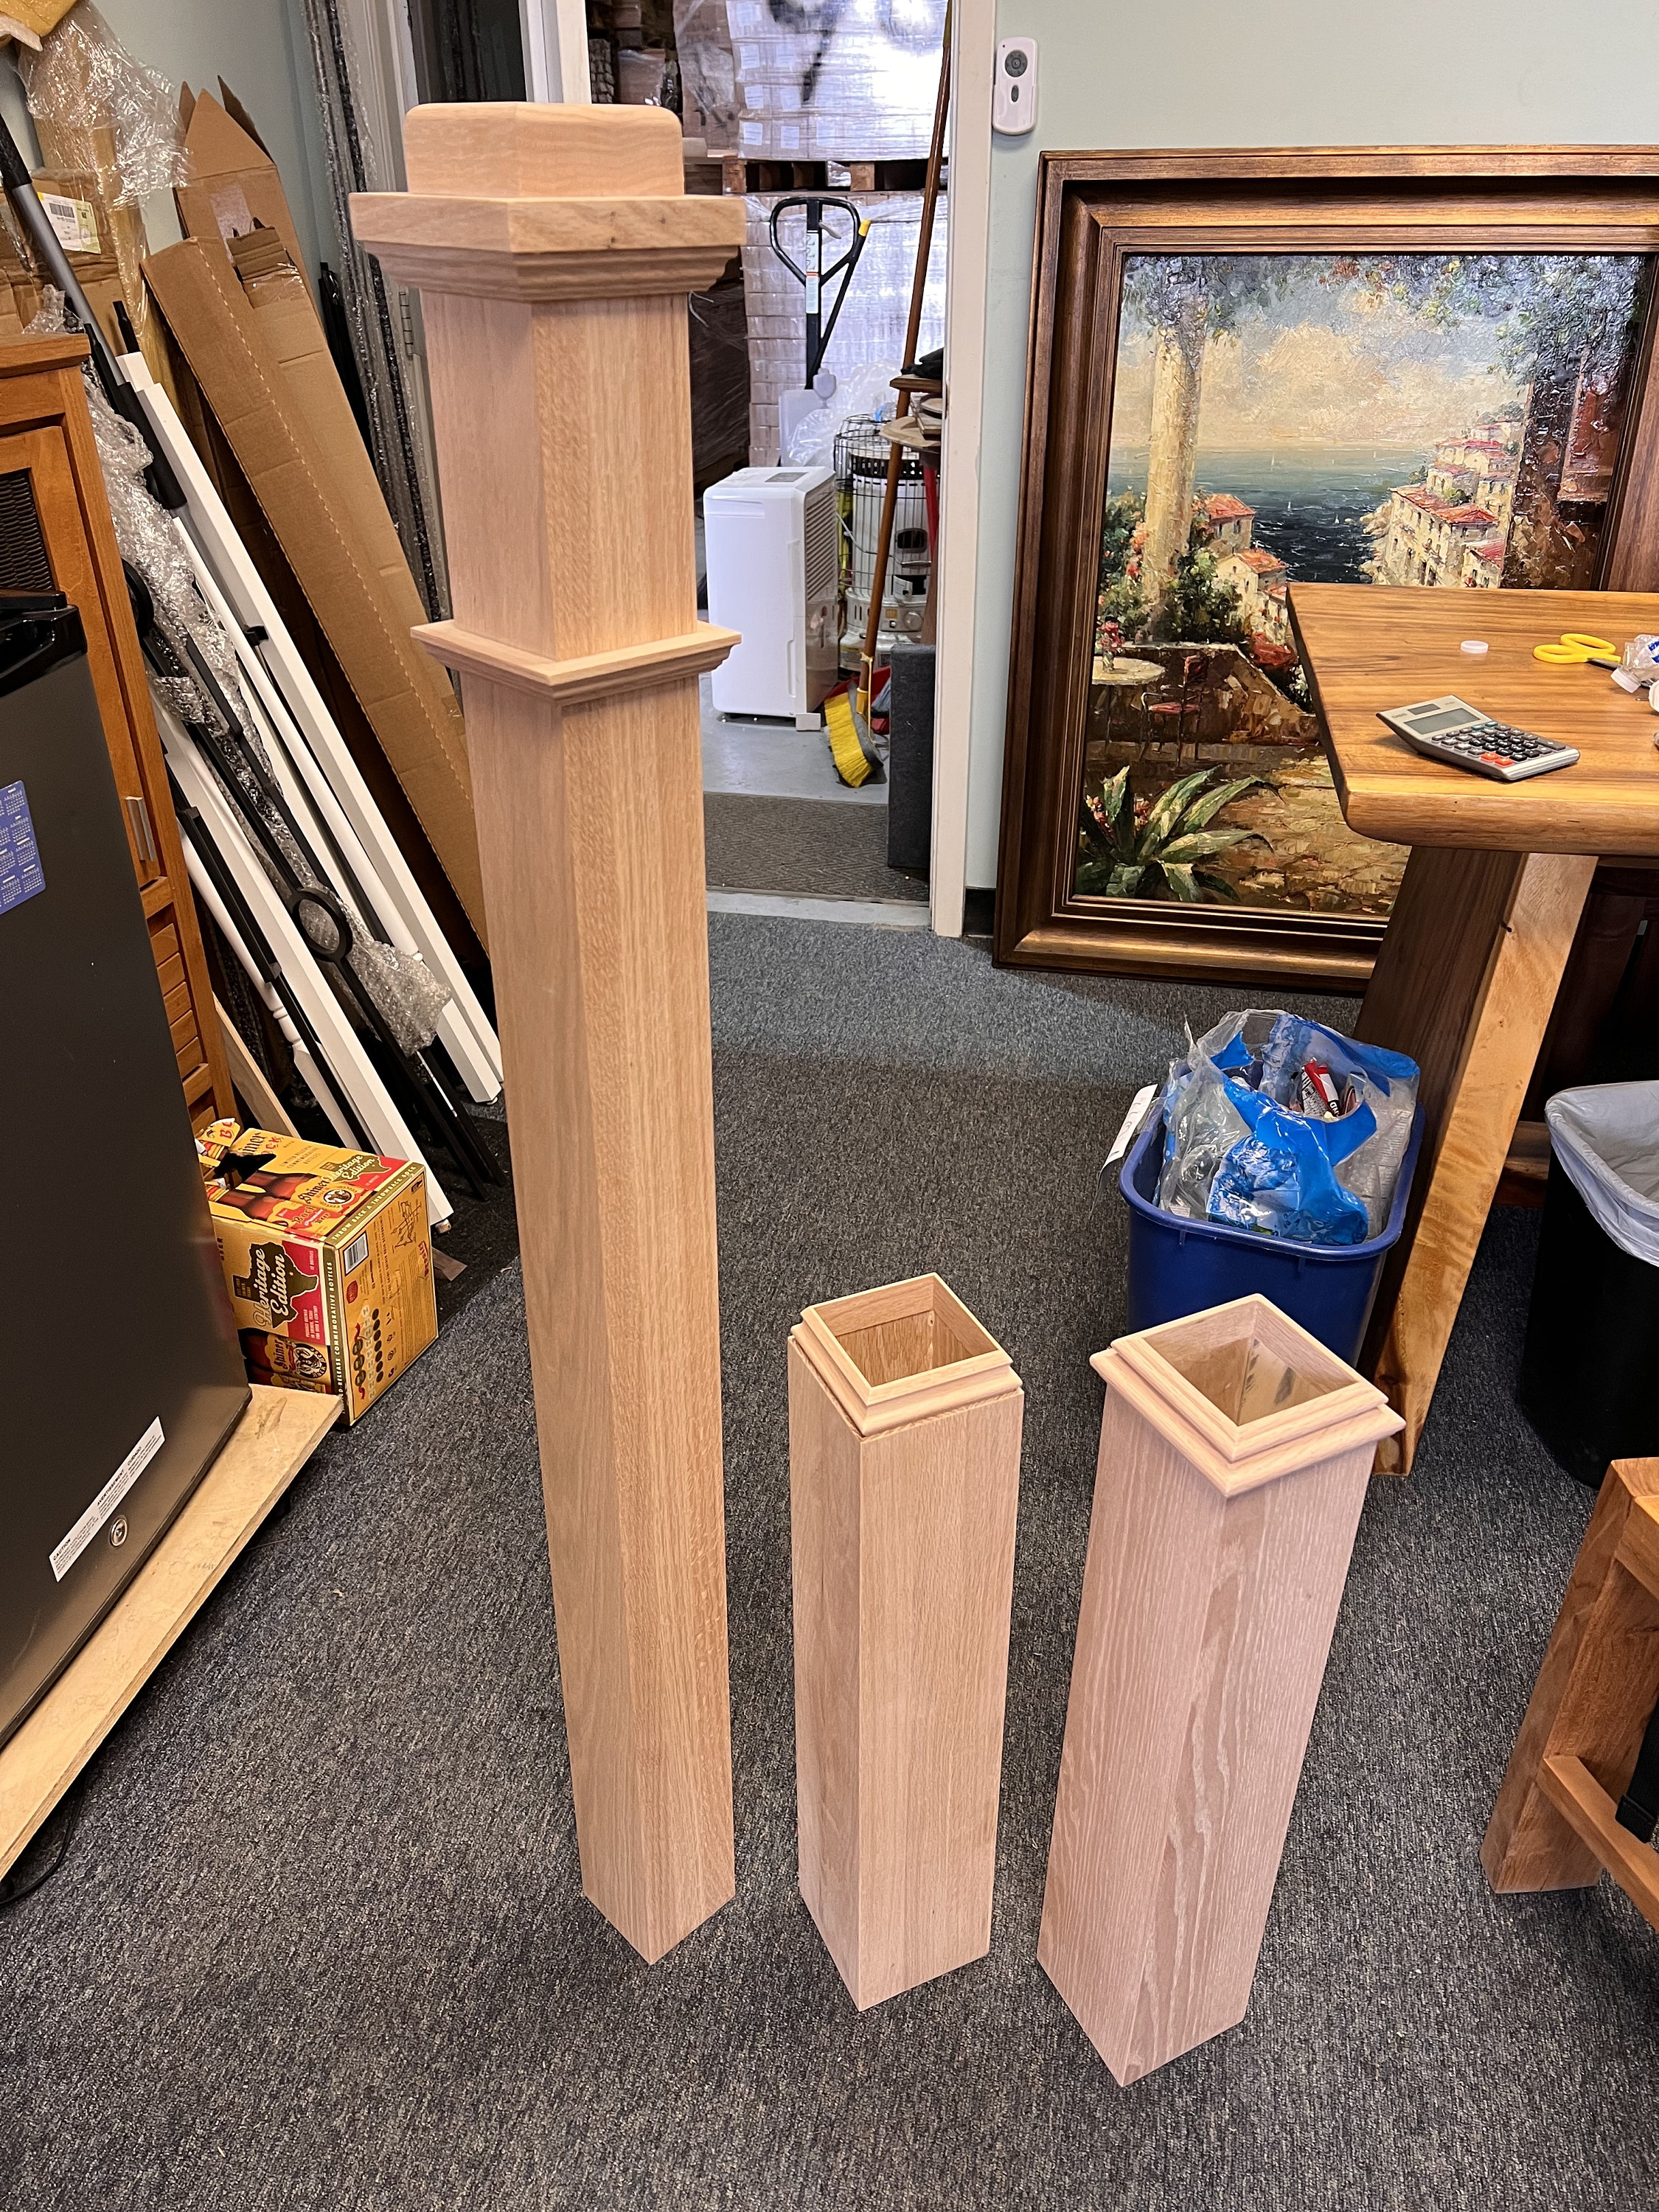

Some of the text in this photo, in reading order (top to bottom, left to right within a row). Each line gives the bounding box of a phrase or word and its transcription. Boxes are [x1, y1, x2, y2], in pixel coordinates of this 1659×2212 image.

[298, 1180, 330, 1204] Shiner
[321, 1155, 363, 1181] Heritage
[341, 1158, 375, 1179] Edition
[332, 1223, 352, 1240] THROW
[352, 1209, 367, 1222] BACK
[371, 1178, 403, 1205] THROWBACK
[401, 1166, 417, 1178] BOCK
[253, 1248, 271, 1326] Heritage
[270, 1253, 288, 1316] Edition
[274, 1339, 288, 1370] Shiner
[329, 1294, 341, 1355] COMMEMORATIVE
[53, 1538, 71, 1561] CAUTION
[97, 1469, 125, 1506] AVERTISSEMENT
